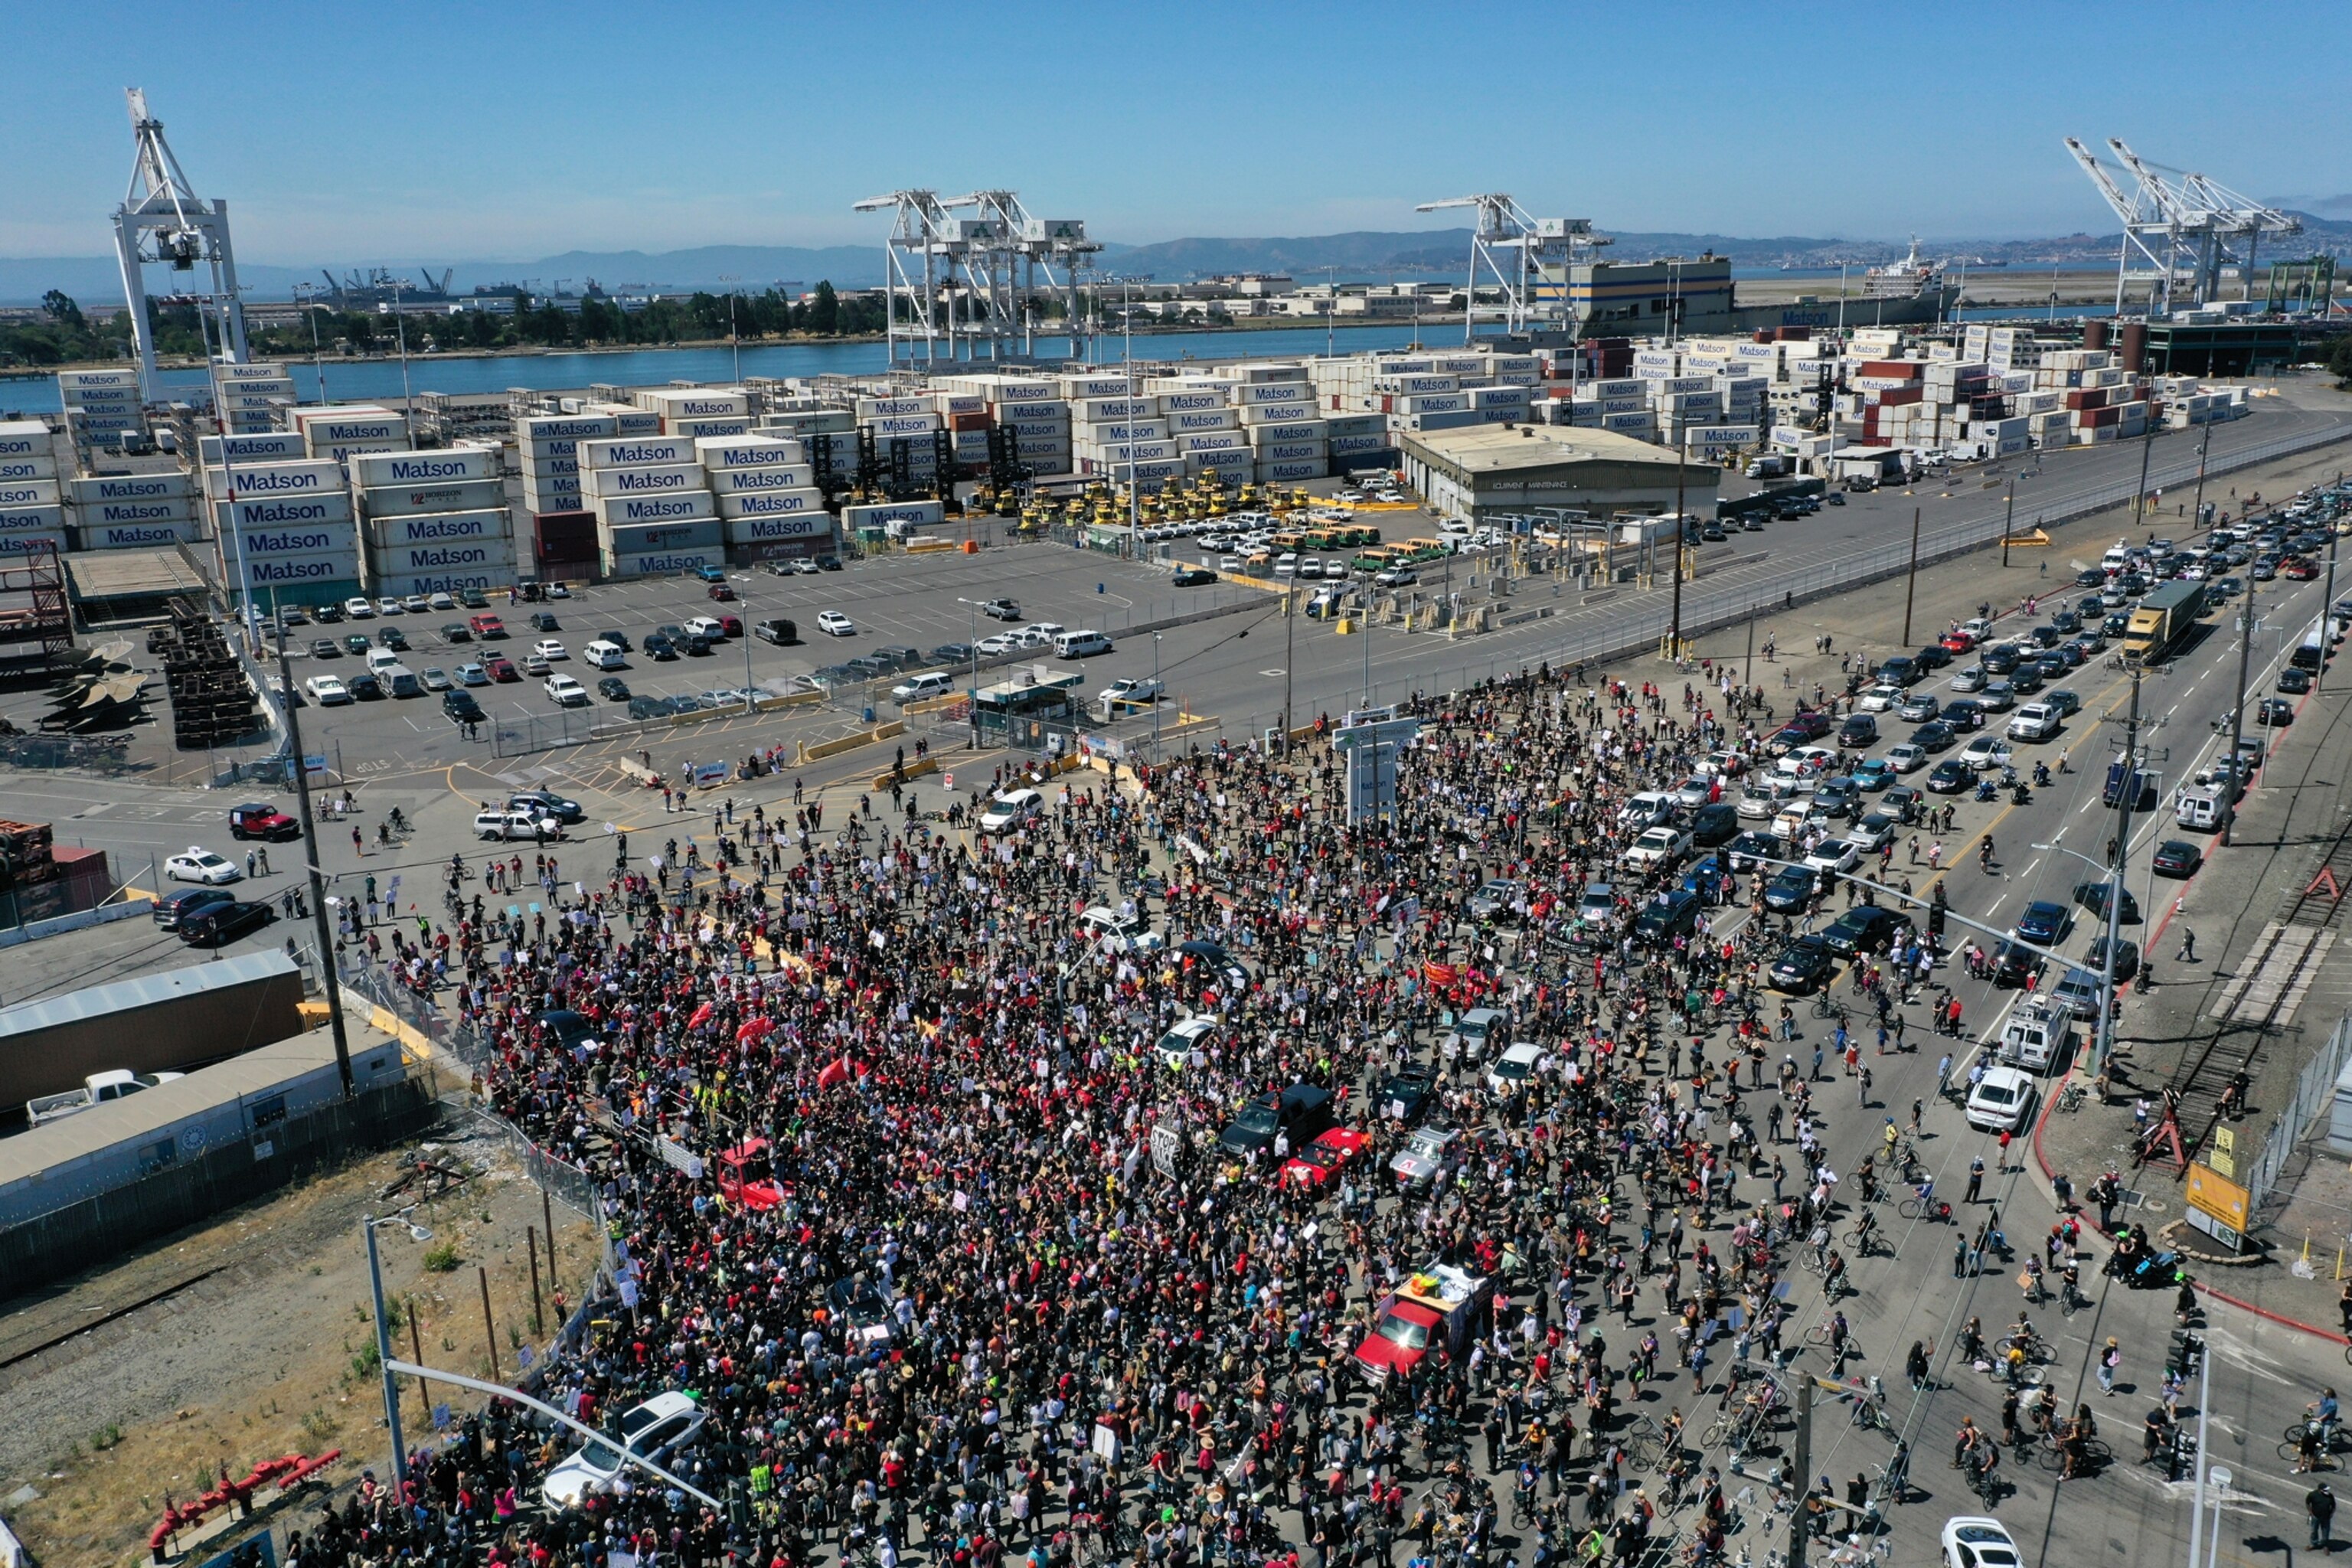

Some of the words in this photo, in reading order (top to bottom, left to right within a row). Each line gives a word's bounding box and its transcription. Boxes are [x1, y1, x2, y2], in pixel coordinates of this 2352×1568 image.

[1782, 311, 1828, 325] Matson
[1697, 344, 1725, 354] Matson
[1739, 346, 1770, 357] Matson
[1934, 348, 1951, 357] Matson
[1502, 361, 1532, 371] Matson
[1640, 355, 1668, 365] Matson
[1688, 358, 1717, 368] Matson
[234, 368, 272, 377] Matson
[1391, 364, 1423, 374] Matson
[1446, 361, 1477, 372] Matson
[1726, 365, 1748, 374] Matson
[1640, 369, 1668, 378] Matson
[79, 376, 119, 385] Matson
[1412, 379, 1450, 391] Matson
[1502, 376, 1531, 384] Matson
[1862, 381, 1894, 390] Matson
[2007, 380, 2026, 390] Matson
[240, 384, 279, 392] Matson
[1007, 387, 1047, 399] Matson
[1089, 383, 1128, 394] Matson
[1606, 385, 1637, 396] Matson
[1674, 382, 1704, 392] Matson
[1732, 384, 1753, 392] Matson
[82, 391, 123, 400] Matson
[1256, 388, 1295, 400] Matson
[1486, 393, 1521, 405] Matson
[243, 398, 269, 407] Mats
[684, 403, 733, 413] Matson
[876, 402, 919, 414] Matson
[951, 400, 980, 410] Matson
[1171, 397, 1214, 409] Matson
[1421, 399, 1457, 410] Matson
[1606, 401, 1636, 412] Matson
[2036, 397, 2054, 408] Matson
[84, 405, 126, 413] Matson
[1014, 407, 1055, 418] Matson
[1265, 407, 1303, 420] Matson
[1181, 416, 1222, 427] Matson
[1485, 410, 1519, 422] Matson
[87, 420, 128, 429] Matson
[622, 419, 656, 427] Matson
[883, 420, 926, 432] Matson
[1615, 417, 1645, 428] Matson
[330, 423, 389, 439] Matson
[548, 423, 600, 436] Matson
[694, 423, 743, 436] Matson
[1016, 424, 1056, 436] Matson
[1273, 426, 1312, 439] Matson
[959, 434, 987, 444] Matson
[1705, 431, 1749, 442] Matson
[1776, 430, 1795, 443] Matson
[1191, 438, 1231, 449] Matson
[1338, 437, 1377, 450] Matson
[2002, 442, 2020, 452] Matson
[610, 446, 675, 462] Matson
[724, 450, 784, 466] Matson
[1273, 446, 1312, 459] Matson
[1198, 453, 1242, 466] Matson
[393, 460, 466, 479] Matson
[1273, 465, 1312, 477] Matson
[237, 473, 317, 491] Matson
[619, 474, 684, 490] Matson
[733, 473, 793, 488] Matson
[101, 481, 167, 496] Matson
[425, 489, 462, 498] HORIZON
[628, 501, 693, 518] Matson
[742, 496, 802, 512] Matson
[104, 502, 170, 520] Matson
[244, 502, 325, 523] Matson
[407, 521, 482, 540] Matson
[751, 521, 812, 537] Matson
[108, 528, 174, 543] Matson
[248, 532, 329, 552] Matson
[411, 547, 485, 567] Matson
[639, 555, 704, 572] Matson
[253, 561, 333, 581] Matson
[414, 575, 488, 594] Matson
[1153, 1130, 1175, 1149] STOP
